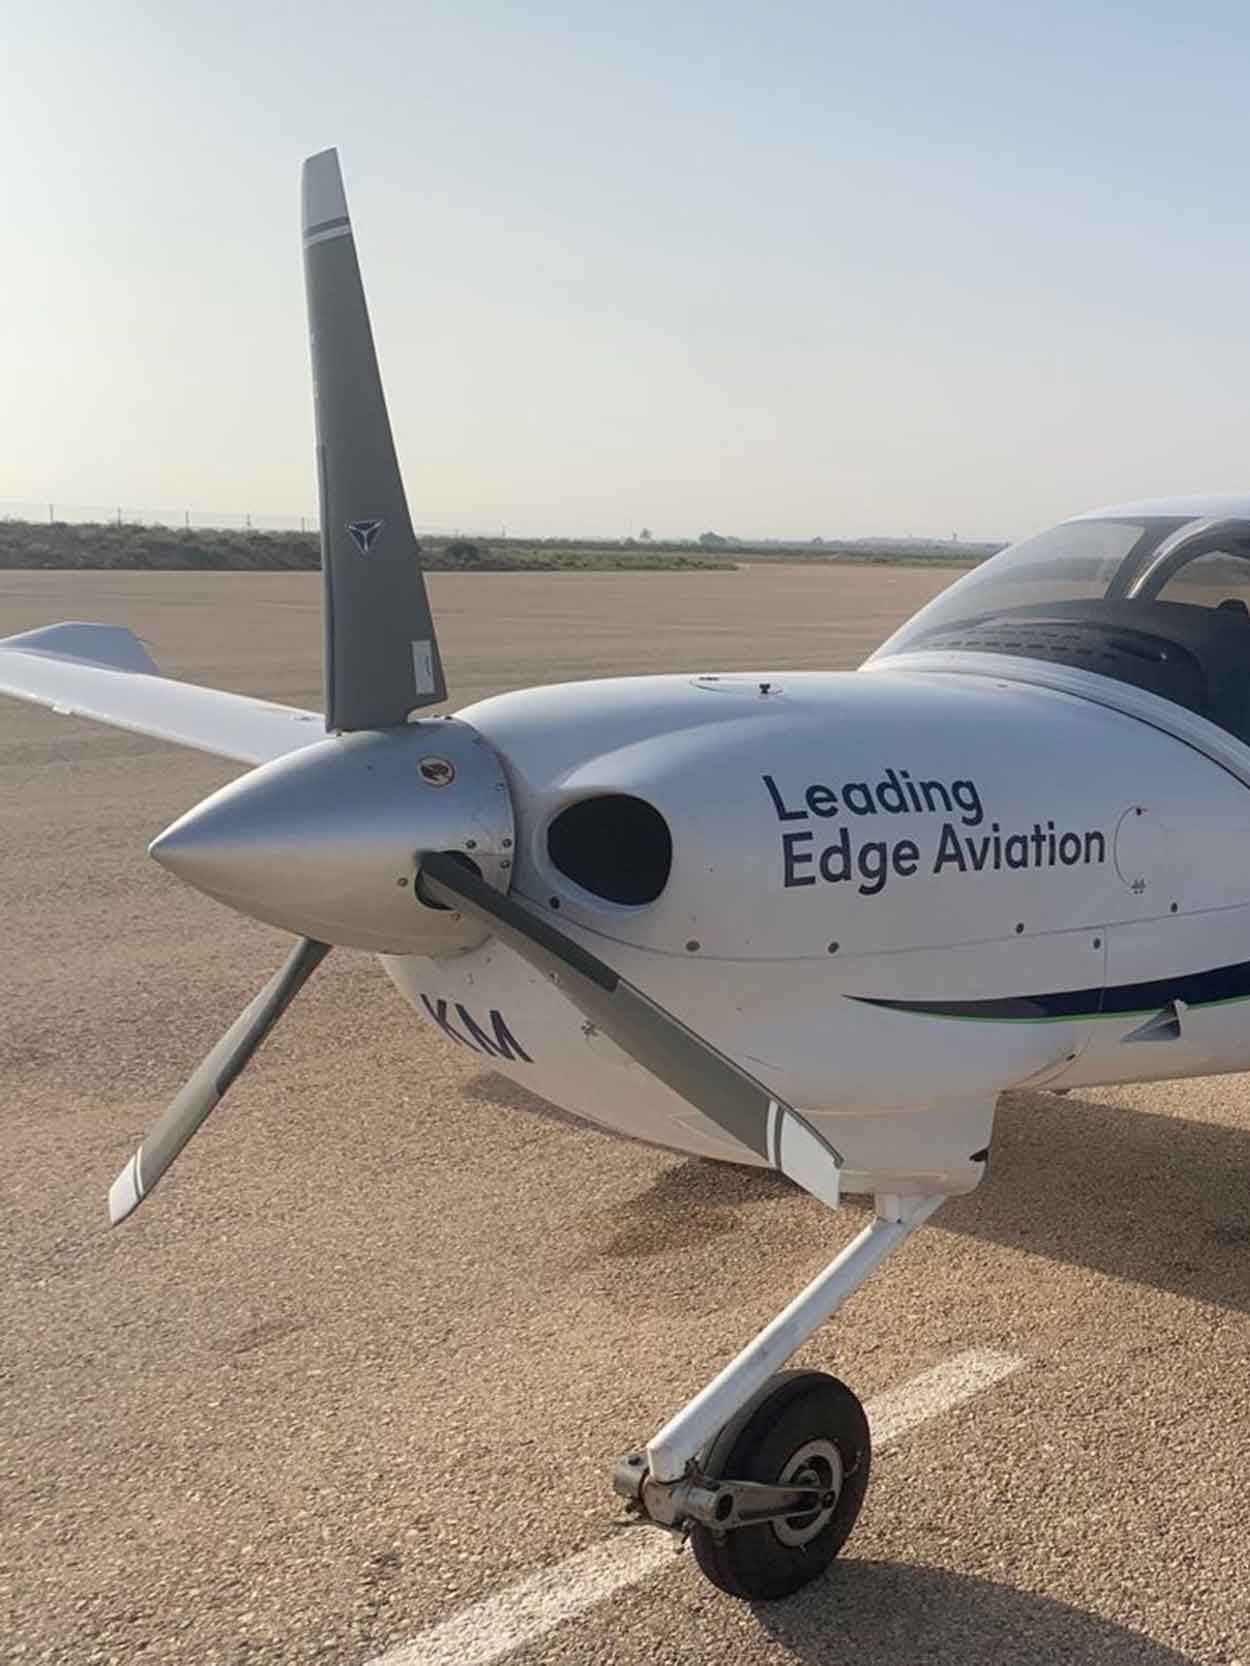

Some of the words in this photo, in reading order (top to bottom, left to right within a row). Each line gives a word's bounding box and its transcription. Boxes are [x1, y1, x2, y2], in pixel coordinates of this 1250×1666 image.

[762, 768, 984, 827] Leading
[781, 826, 920, 896] Edge
[932, 820, 1105, 874] Aviation
